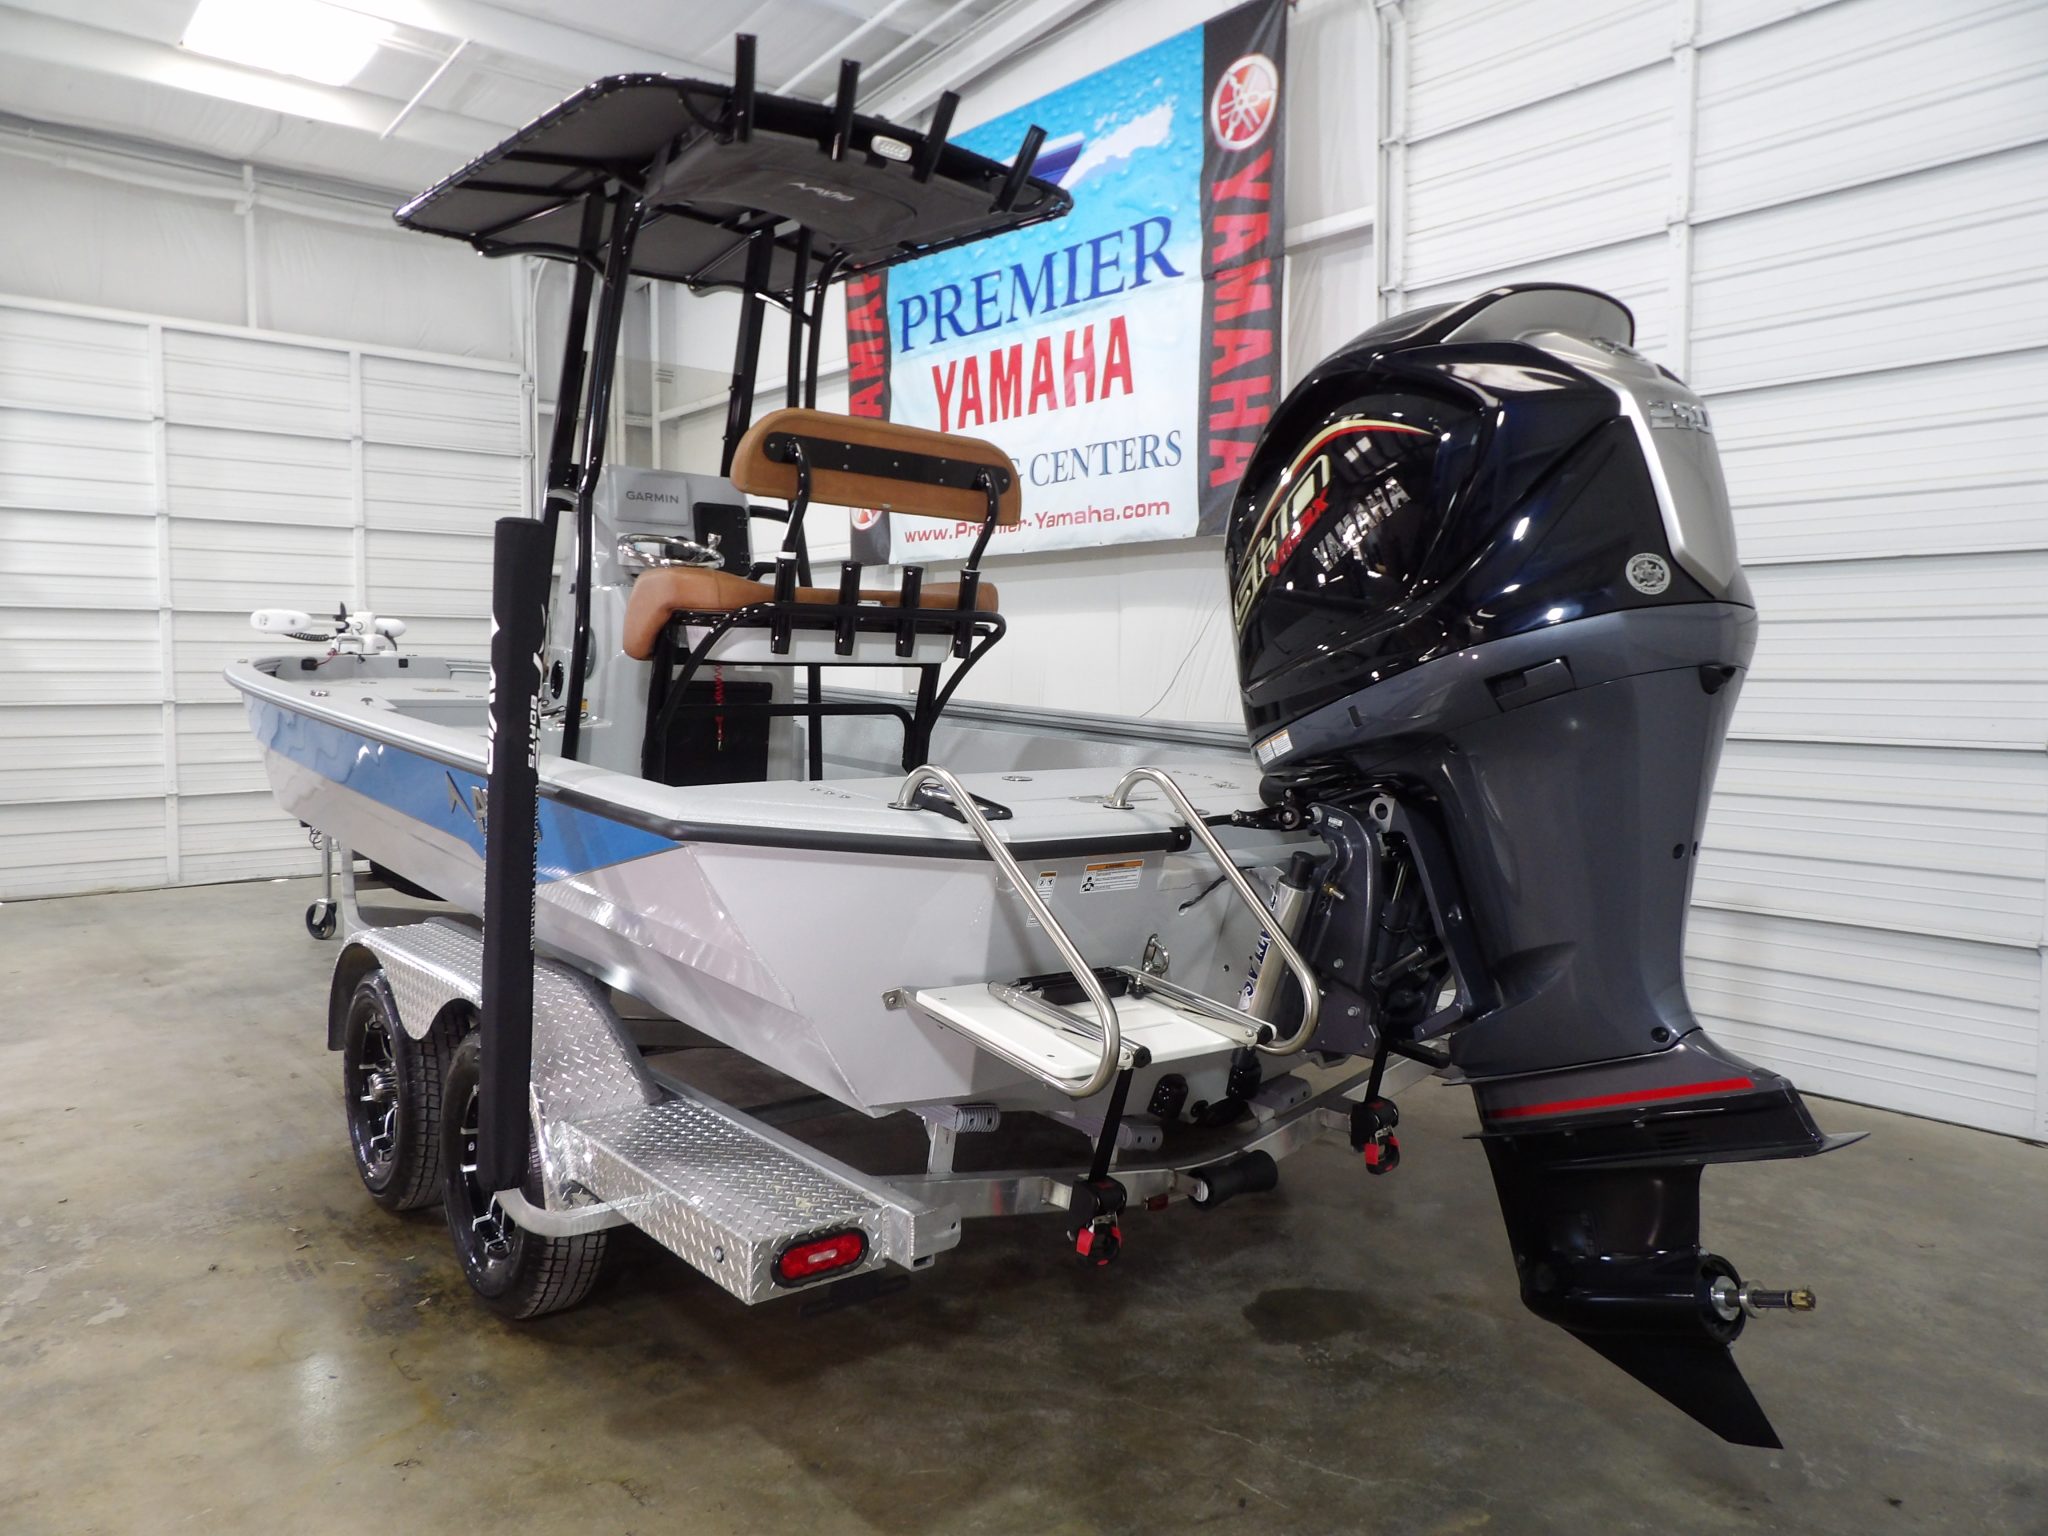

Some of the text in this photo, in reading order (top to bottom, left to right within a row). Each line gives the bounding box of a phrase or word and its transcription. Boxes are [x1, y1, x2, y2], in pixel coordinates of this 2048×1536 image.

[899, 216, 1184, 354] PREMIER
[1209, 148, 1274, 489] YAMAHA
[931, 315, 1134, 434] YAMAHA
[625, 489, 680, 505] GARMIN
[1029, 429, 1182, 487] CENTERS
[904, 501, 1170, 542] www.Preier-Yamaha.com
[1311, 476, 1412, 573] YAMAHA
[528, 694, 539, 769] BOATS
